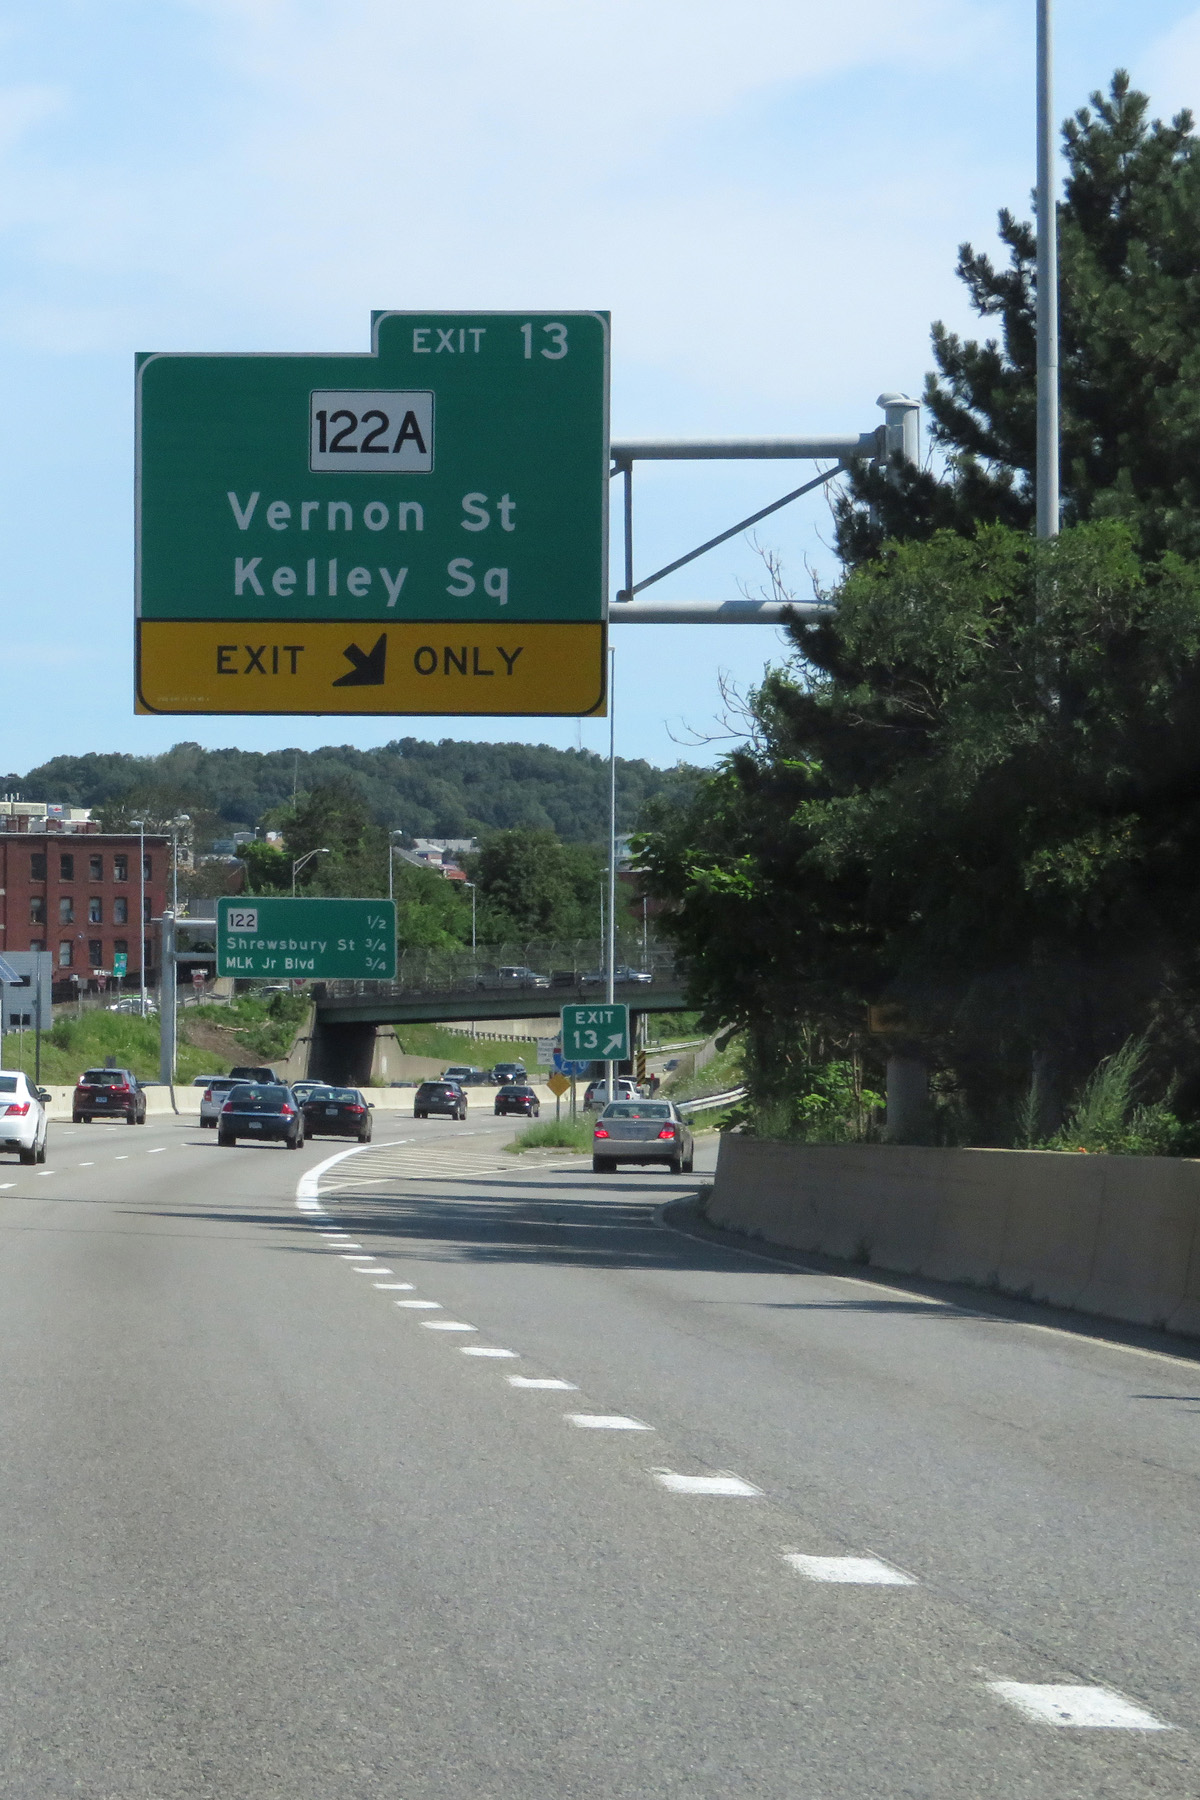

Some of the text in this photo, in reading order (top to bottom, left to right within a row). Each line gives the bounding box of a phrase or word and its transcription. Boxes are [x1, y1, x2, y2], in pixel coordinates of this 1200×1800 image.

[412, 322, 569, 360] EXIT 13
[315, 409, 428, 454] 122A
[226, 491, 516, 532] Vernon St
[234, 557, 509, 608] Kelley Sq
[216, 645, 524, 676] EXIT ONLY
[229, 913, 387, 930] 122 1/2
[226, 936, 386, 954] Shrewsbury St 3/4
[226, 956, 387, 971] MLK Jr Blvd 3/4
[575, 1011, 614, 1025] EXIT
[573, 1029, 598, 1049] 13
